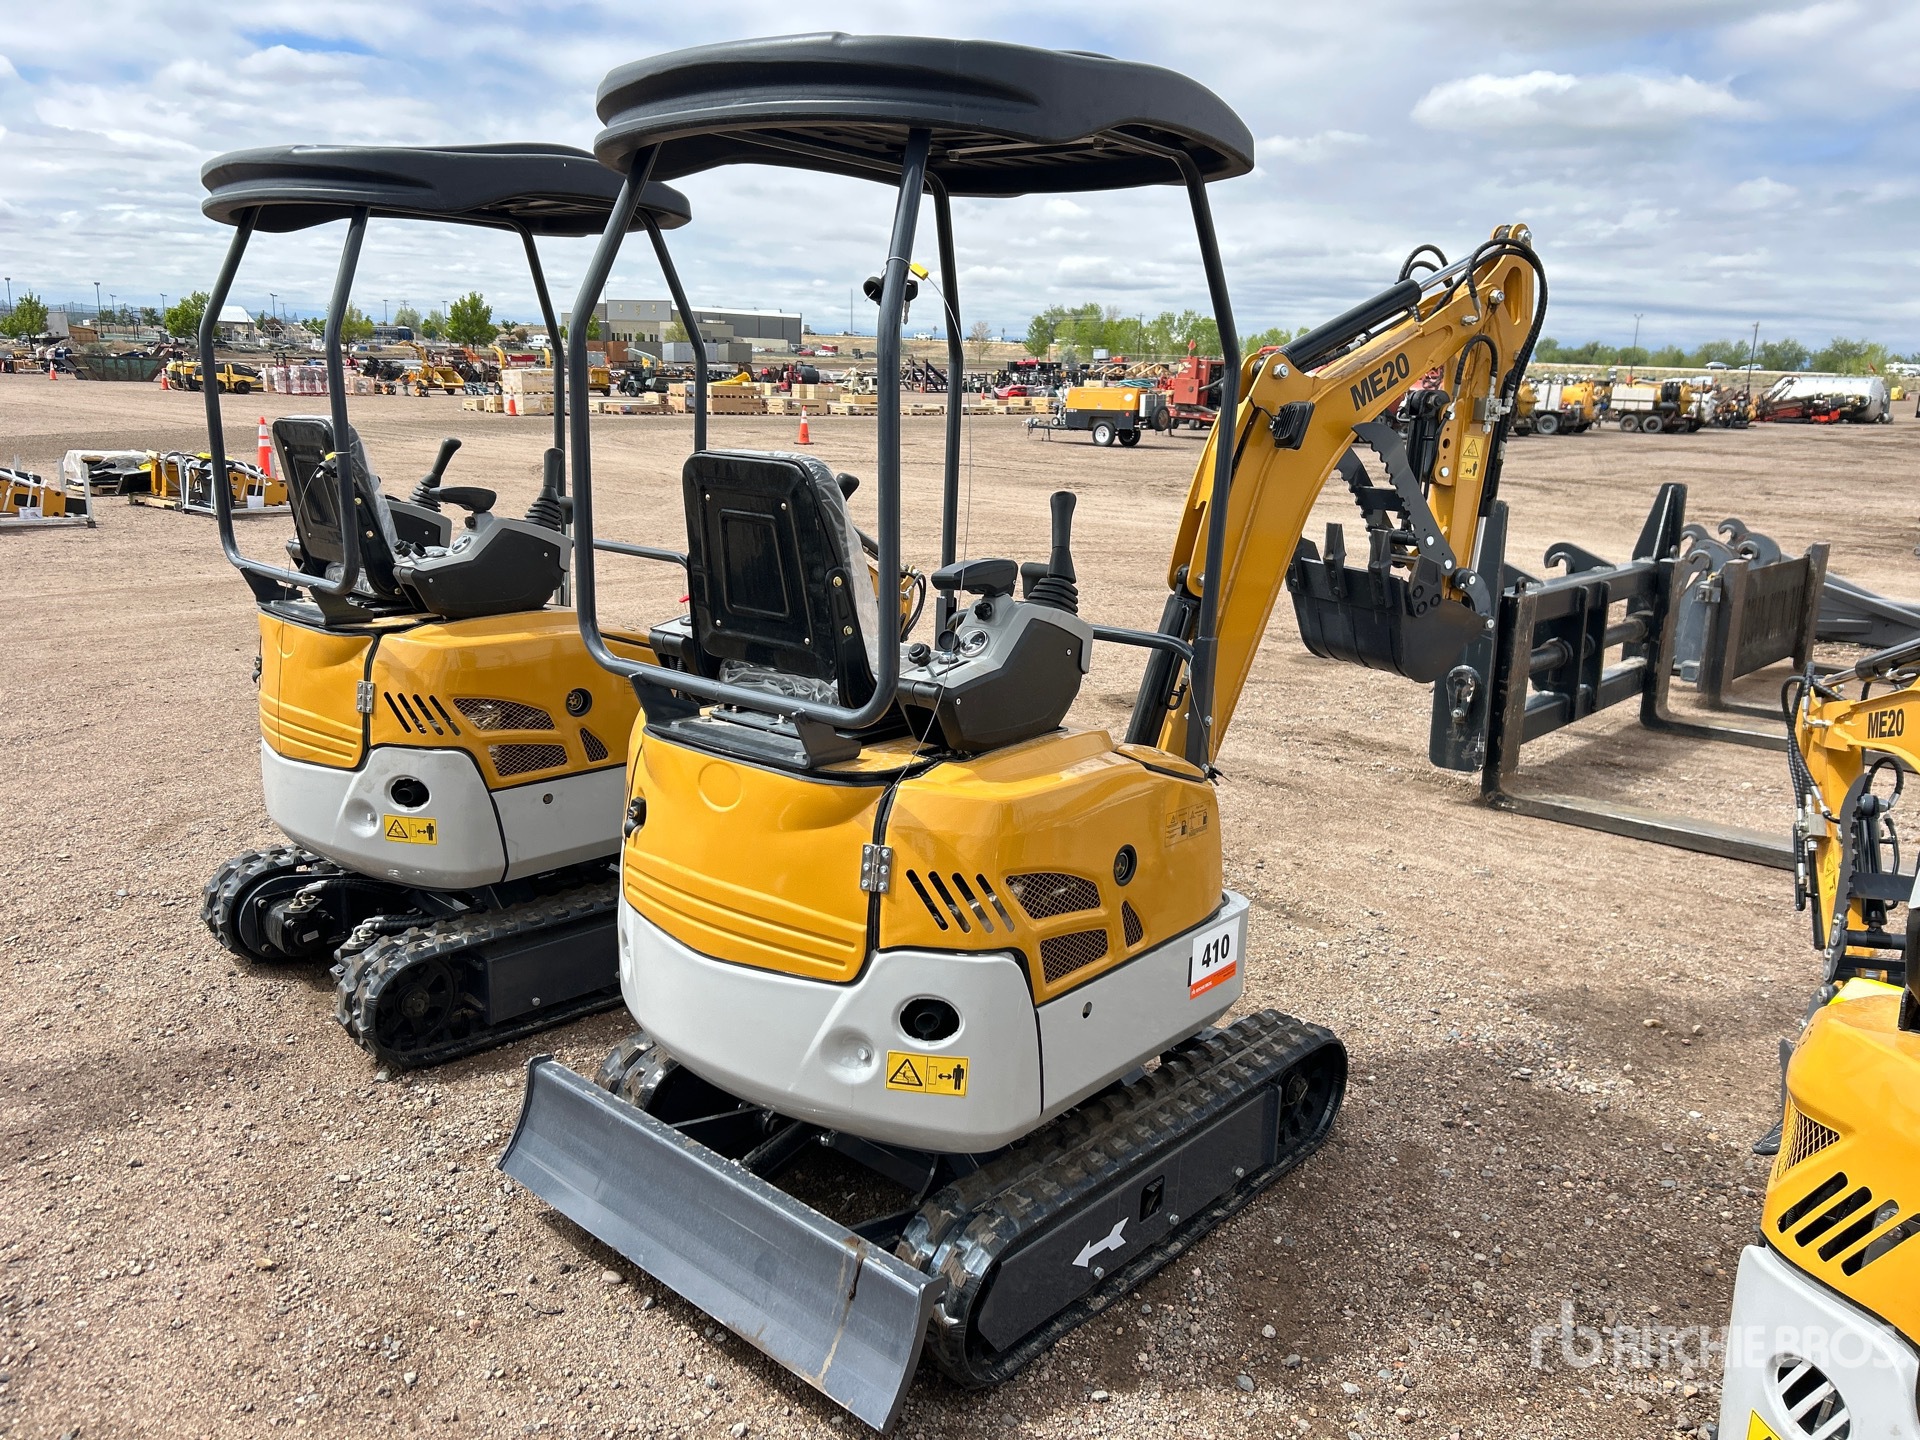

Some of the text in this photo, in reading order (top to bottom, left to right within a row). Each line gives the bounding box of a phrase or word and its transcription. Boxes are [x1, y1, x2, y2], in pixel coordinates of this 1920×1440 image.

[1350, 352, 1410, 412] ME20
[1867, 708, 1905, 739] ME20
[1202, 934, 1230, 968] 410
